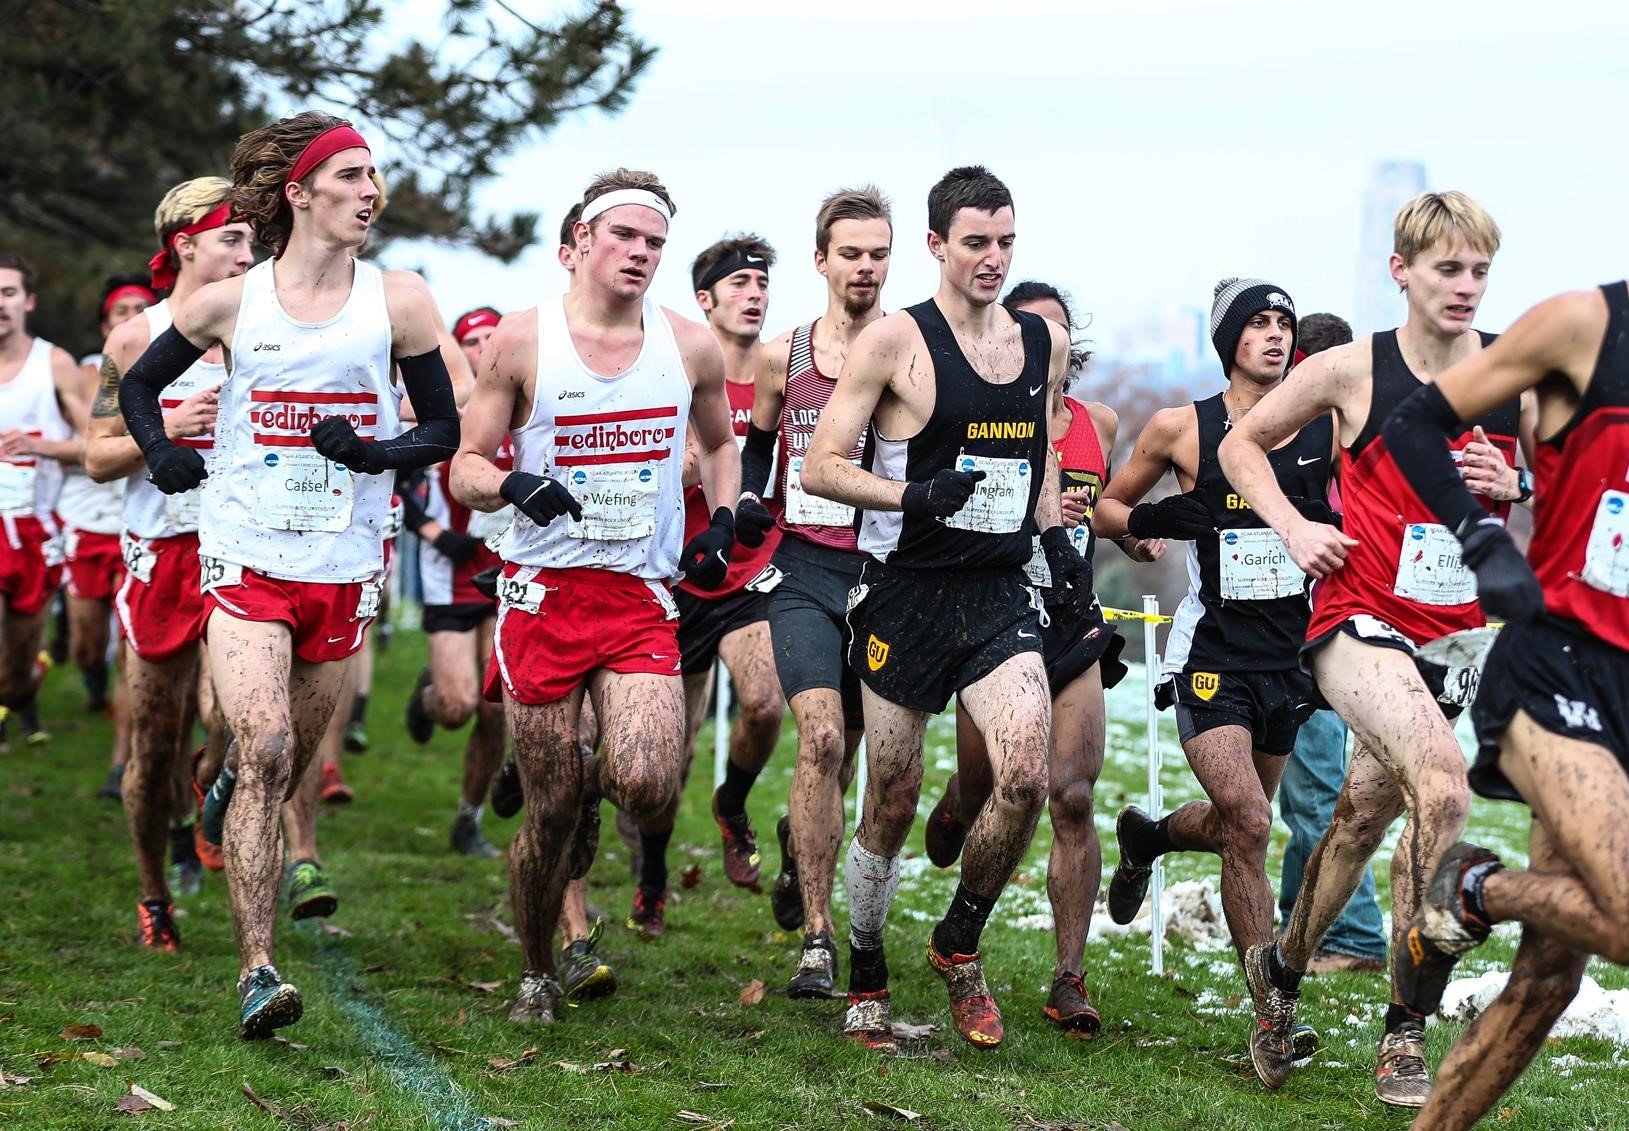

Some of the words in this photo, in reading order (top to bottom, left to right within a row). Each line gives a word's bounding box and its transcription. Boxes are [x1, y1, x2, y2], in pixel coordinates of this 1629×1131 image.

[262, 344, 281, 352] asics
[567, 391, 586, 399] asics
[790, 408, 823, 426] LOC
[570, 424, 664, 451] edinboro
[967, 421, 1035, 439] GANNON
[285, 478, 327, 493] Cassel
[975, 483, 1014, 500] Ingram
[591, 492, 637, 507] Wefing
[1244, 552, 1286, 566] Garich
[868, 641, 886, 663] GU
[1194, 674, 1216, 691] GU
